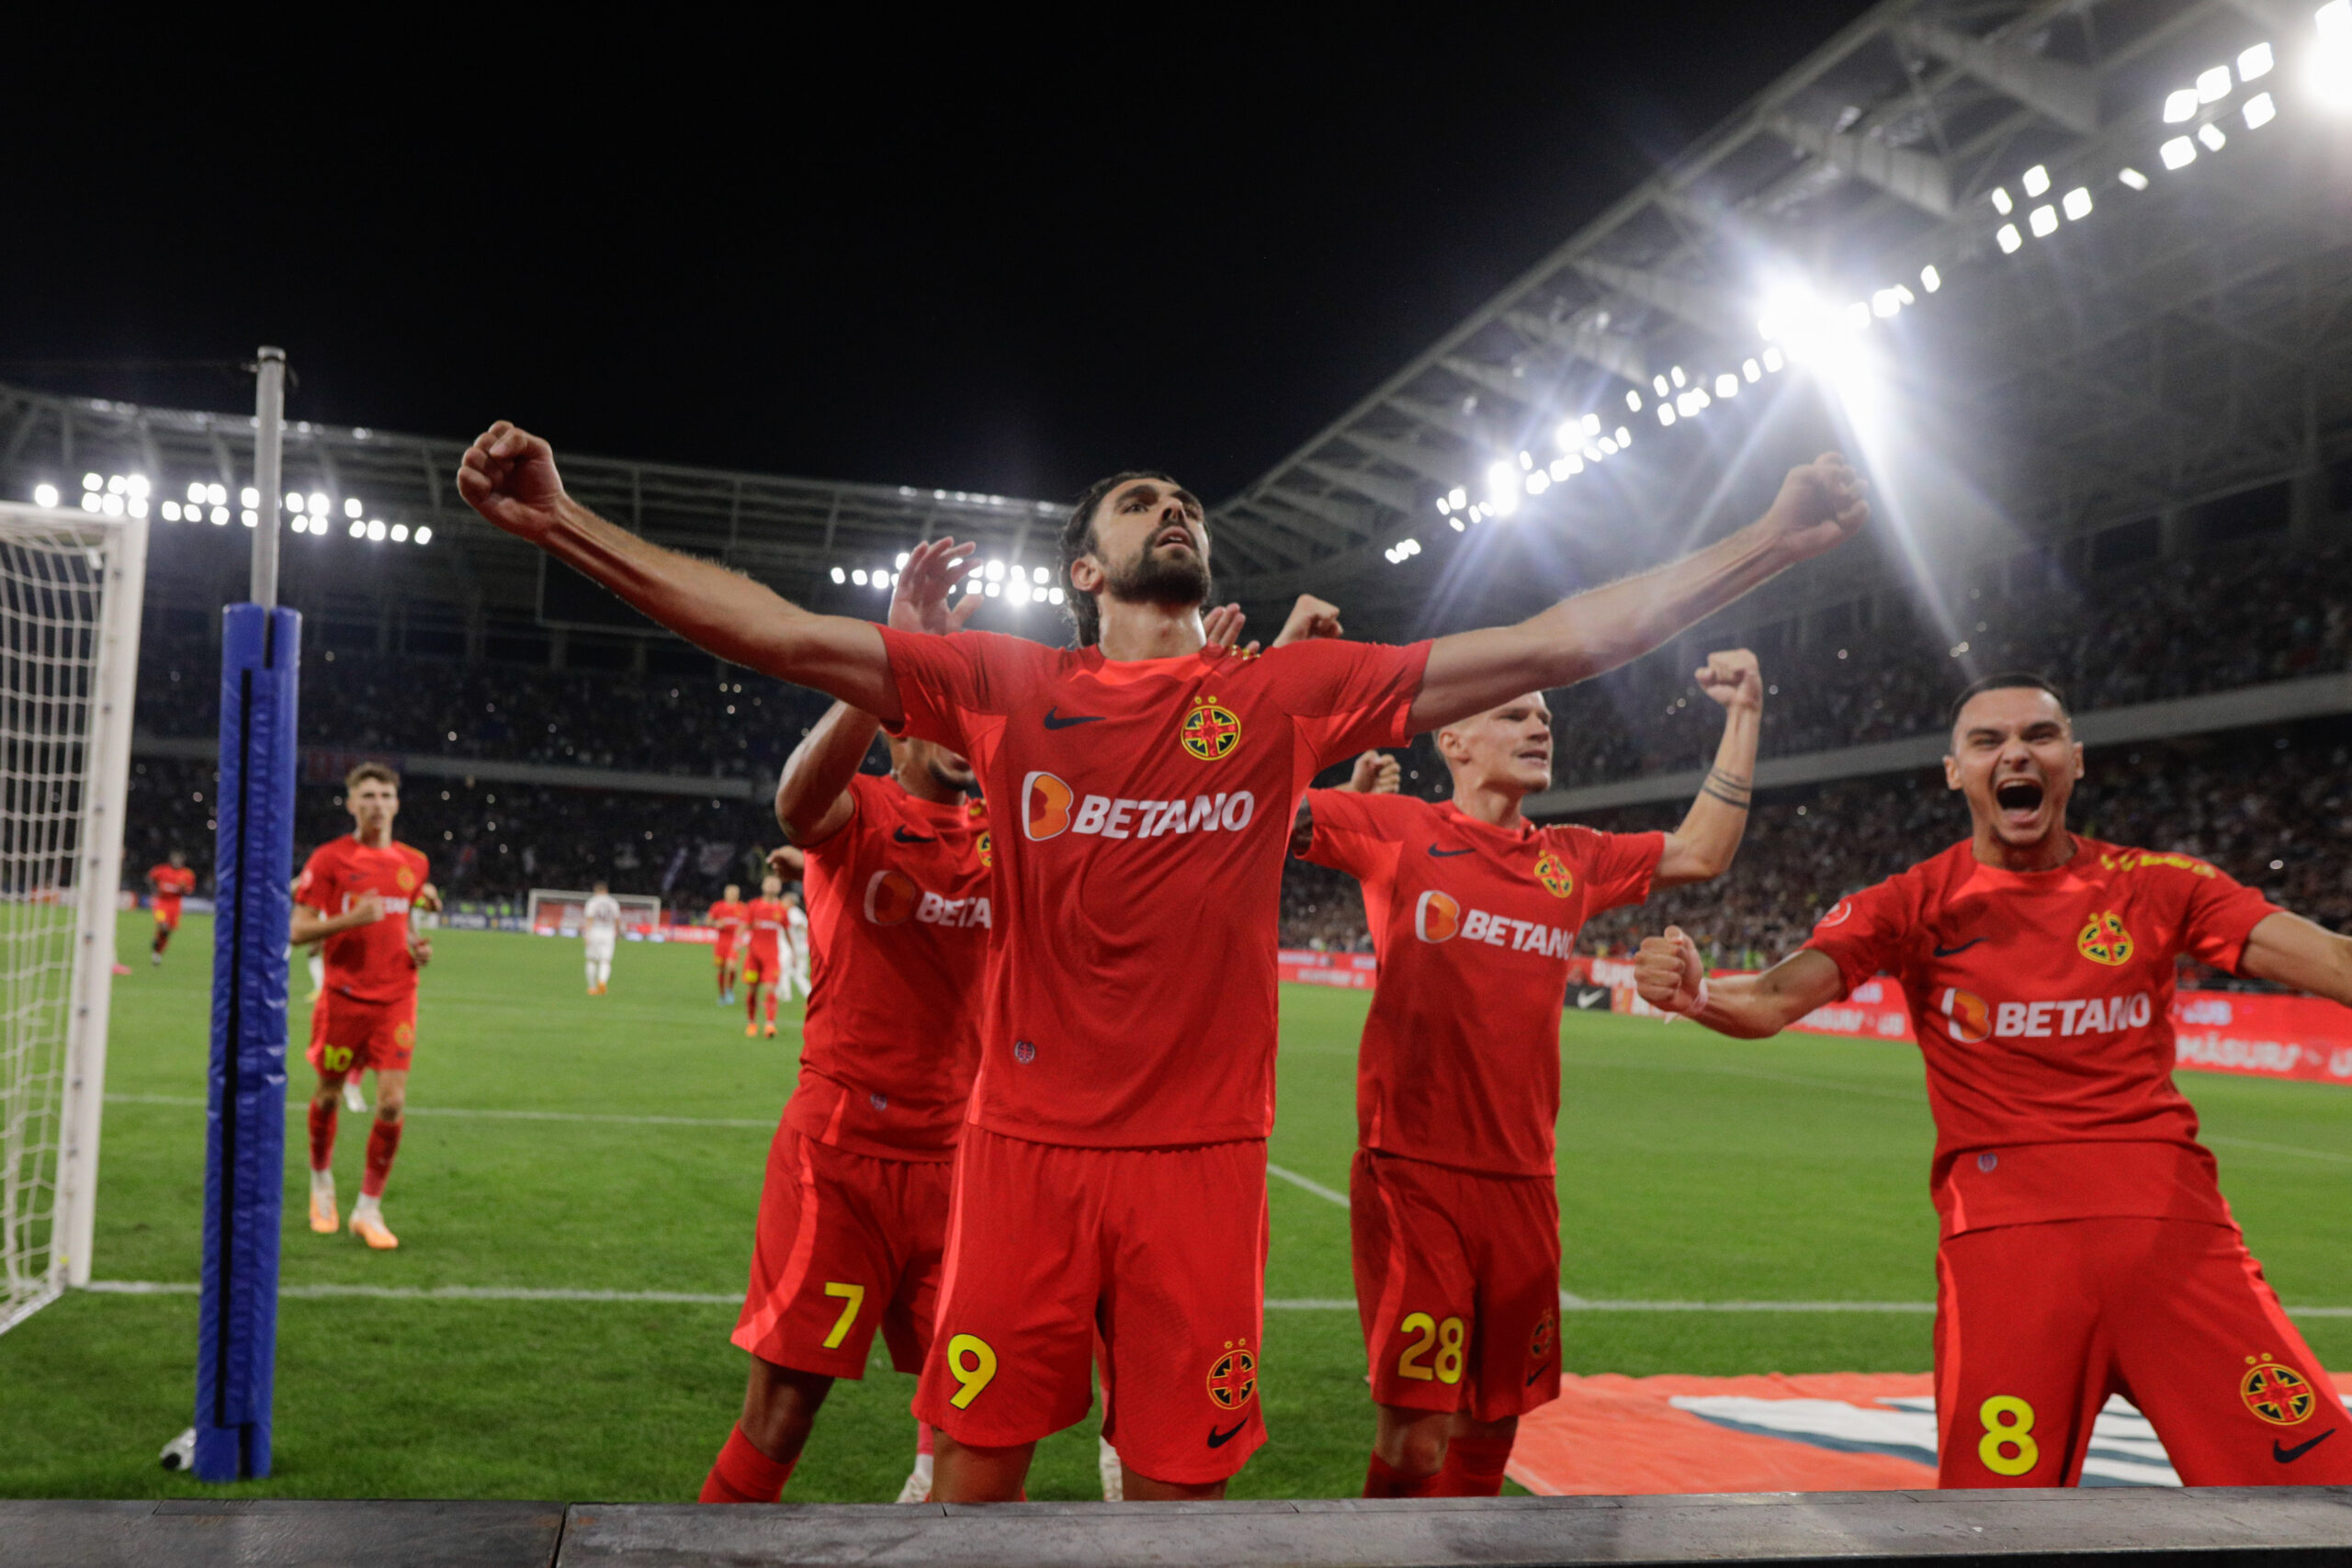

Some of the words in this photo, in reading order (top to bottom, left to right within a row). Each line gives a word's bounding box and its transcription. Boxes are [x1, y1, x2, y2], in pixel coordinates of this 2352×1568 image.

[1071, 790, 1255, 840] BETANO
[915, 890, 992, 930] BETA
[1994, 991, 2152, 1038] BETANO
[324, 1043, 354, 1073] 10
[821, 1280, 865, 1349] 7
[945, 1332, 999, 1411] 9
[1398, 1311, 1465, 1386] 28
[1977, 1393, 2040, 1477] 8
